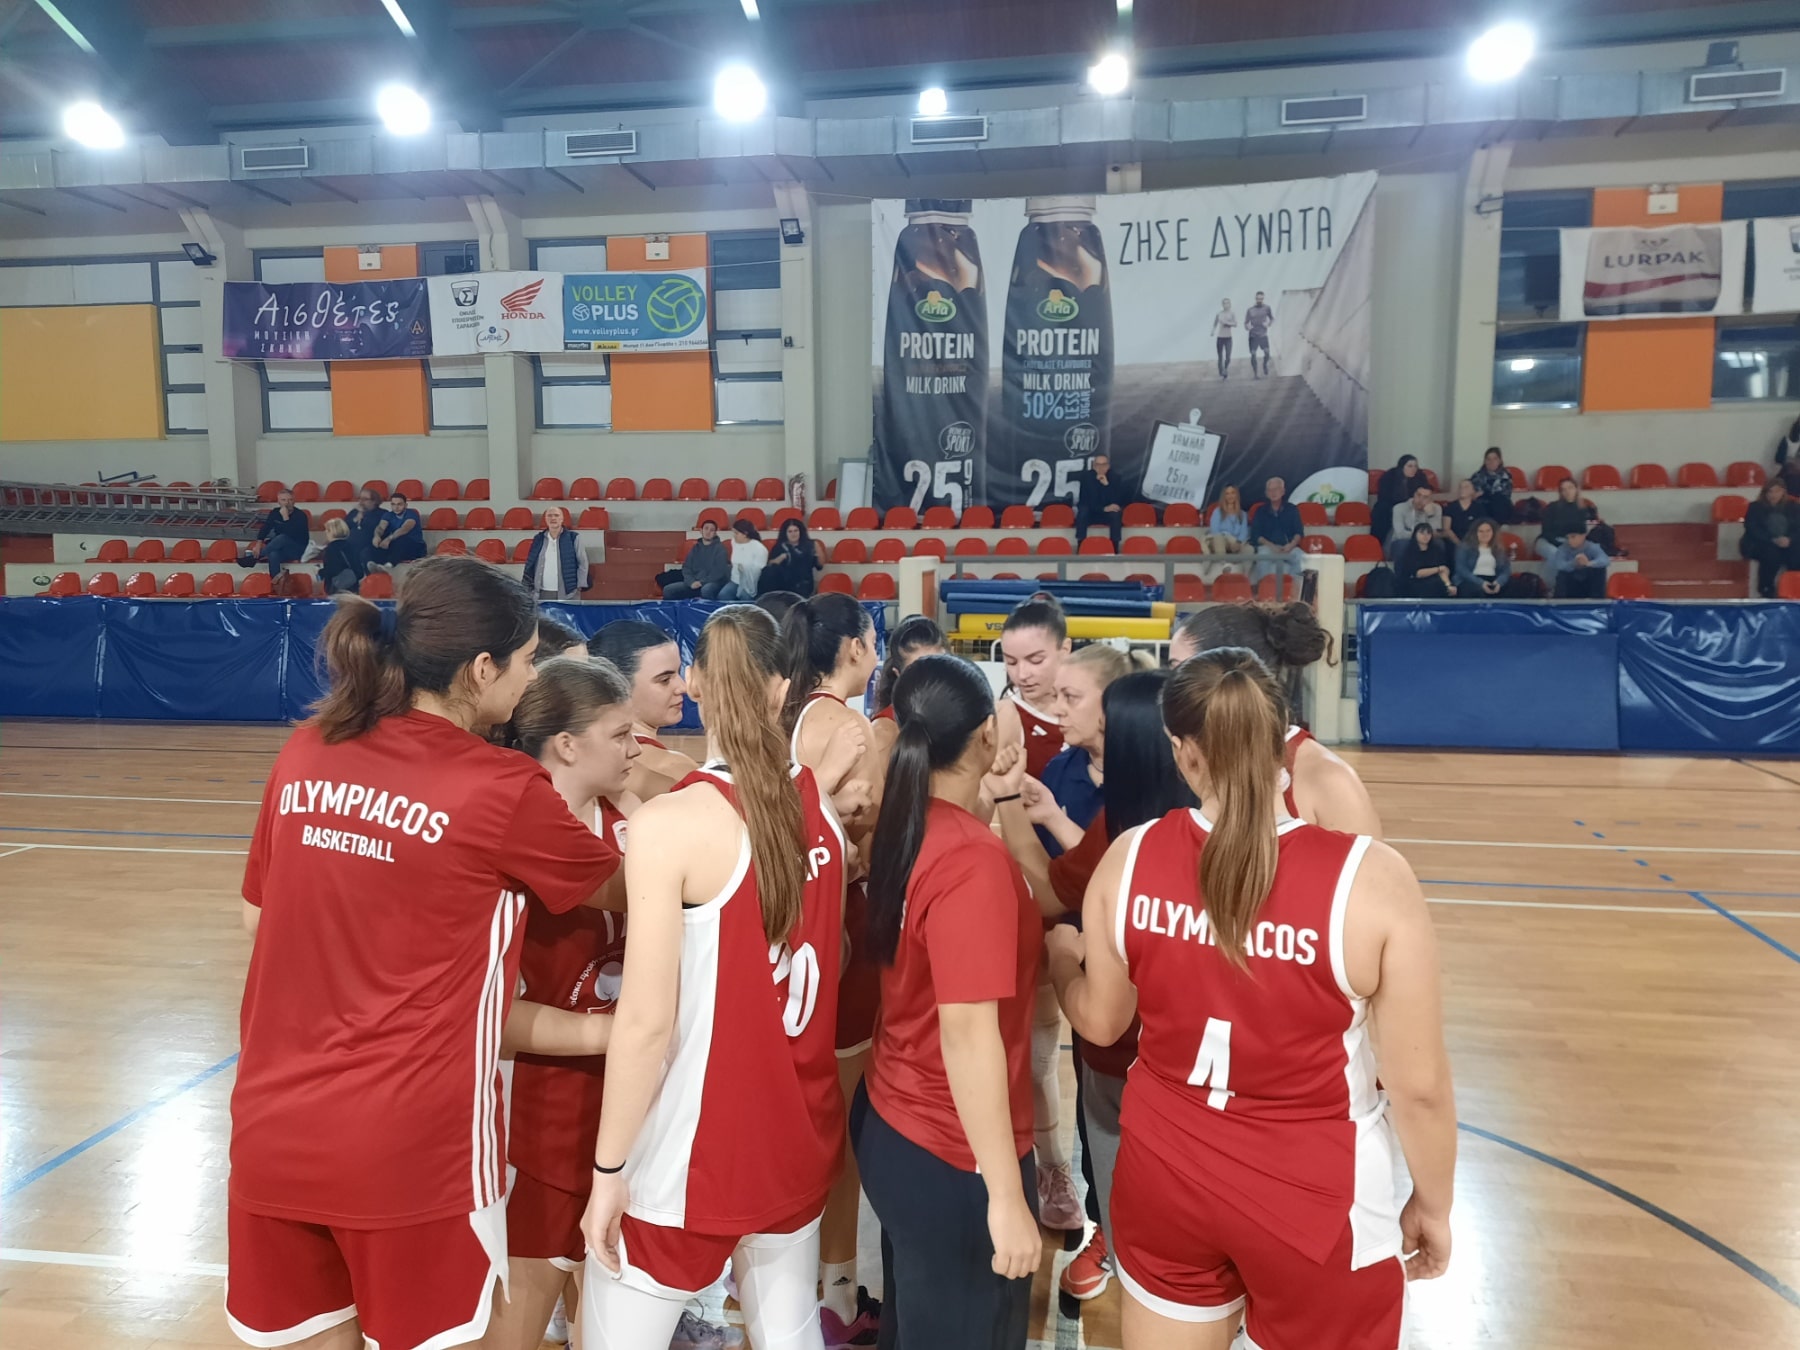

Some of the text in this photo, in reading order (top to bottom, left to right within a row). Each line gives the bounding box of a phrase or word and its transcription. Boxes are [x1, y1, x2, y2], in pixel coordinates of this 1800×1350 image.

[1119, 206, 1332, 265] ΖΗΣΕ ΔΥΝΑΤΑ
[1604, 251, 1704, 268] LURPAK
[572, 285, 638, 301] VOLLEY
[501, 312, 546, 320] HONDA
[591, 304, 639, 321] PLUS
[921, 301, 948, 315] Arla
[1043, 301, 1071, 315] Arla
[571, 327, 639, 337] www.volleyplus.gr
[1016, 327, 1100, 356] PROTEIN
[900, 331, 975, 360] PROTEIN
[906, 375, 967, 394] MILK DRINK
[1023, 372, 1091, 391] MILK DRINK
[1023, 391, 1064, 419] 50%
[1064, 391, 1080, 420] LESS
[279, 780, 450, 844] OLYMPIACOS
[302, 824, 395, 863] BASKETBALL
[1132, 894, 1319, 965] OLYMCOS
